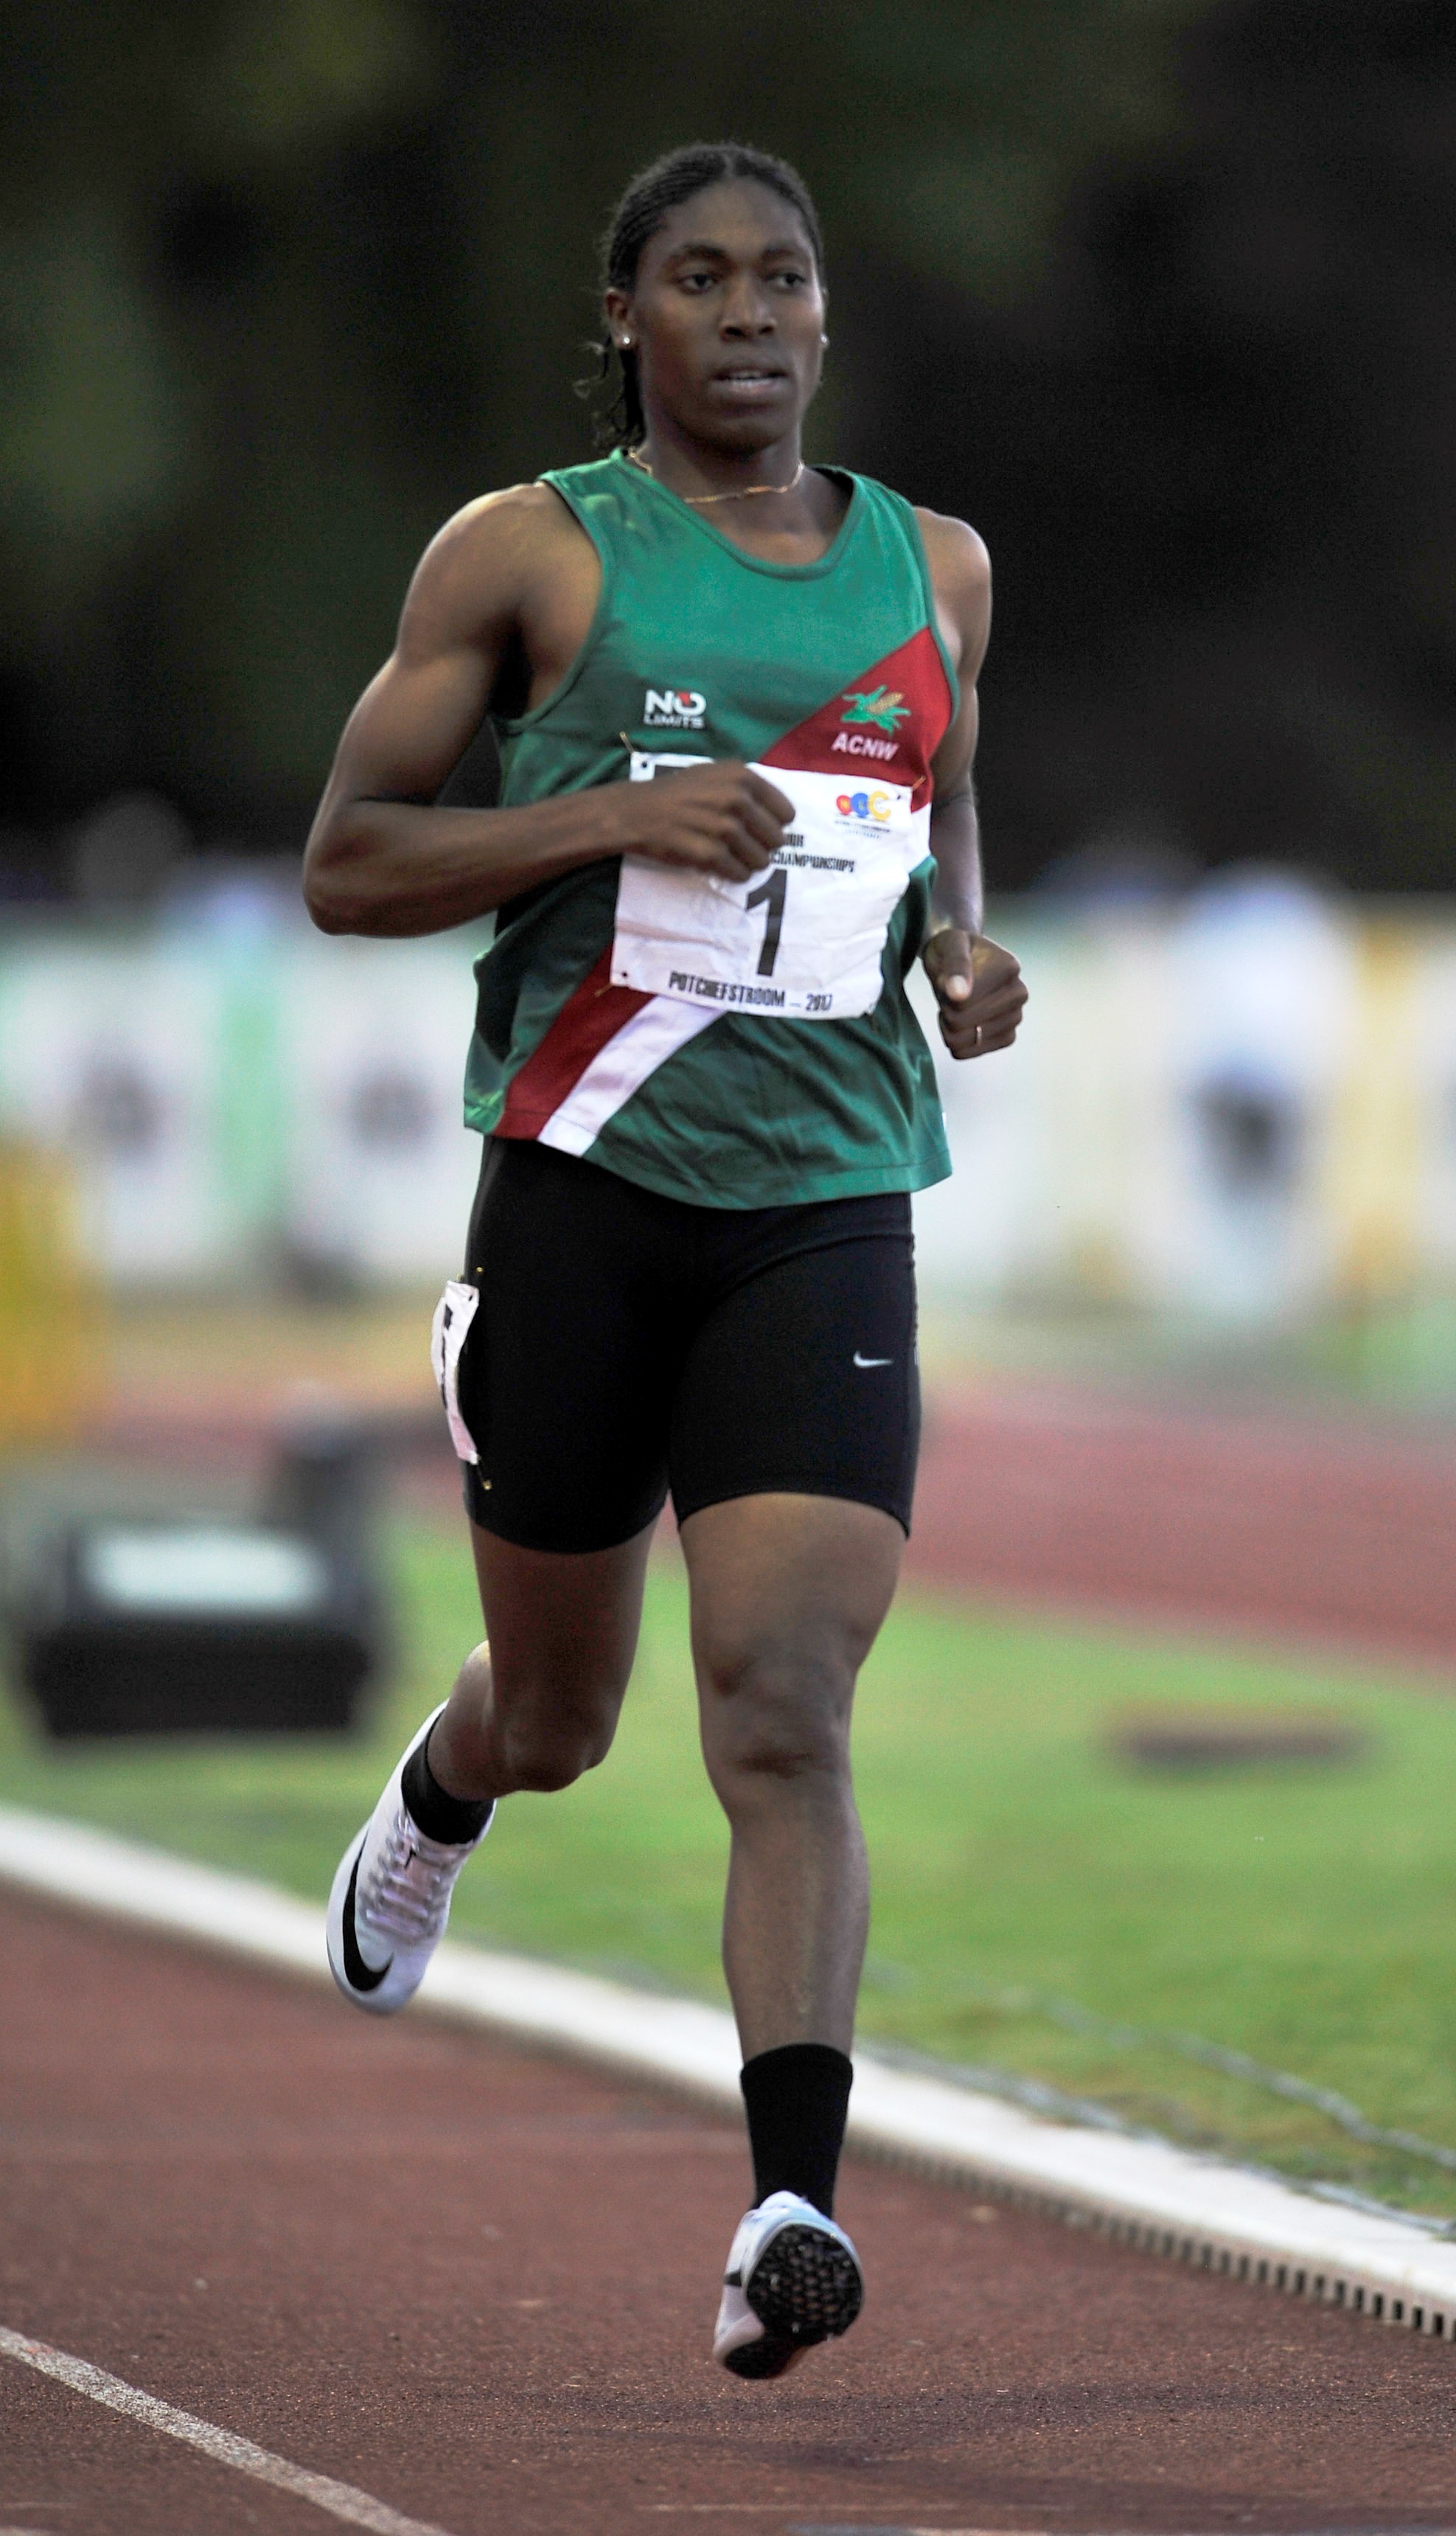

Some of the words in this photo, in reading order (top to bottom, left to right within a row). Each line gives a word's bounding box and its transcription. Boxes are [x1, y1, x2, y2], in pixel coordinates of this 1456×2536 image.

[646, 689, 706, 715] NO
[644, 714, 704, 729] LIMITS
[831, 732, 899, 761] ACNW
[770, 850, 854, 872] CHAMPIONSHIPS
[746, 869, 787, 976] 1
[669, 970, 785, 1007] POTCHEFSTROOM
